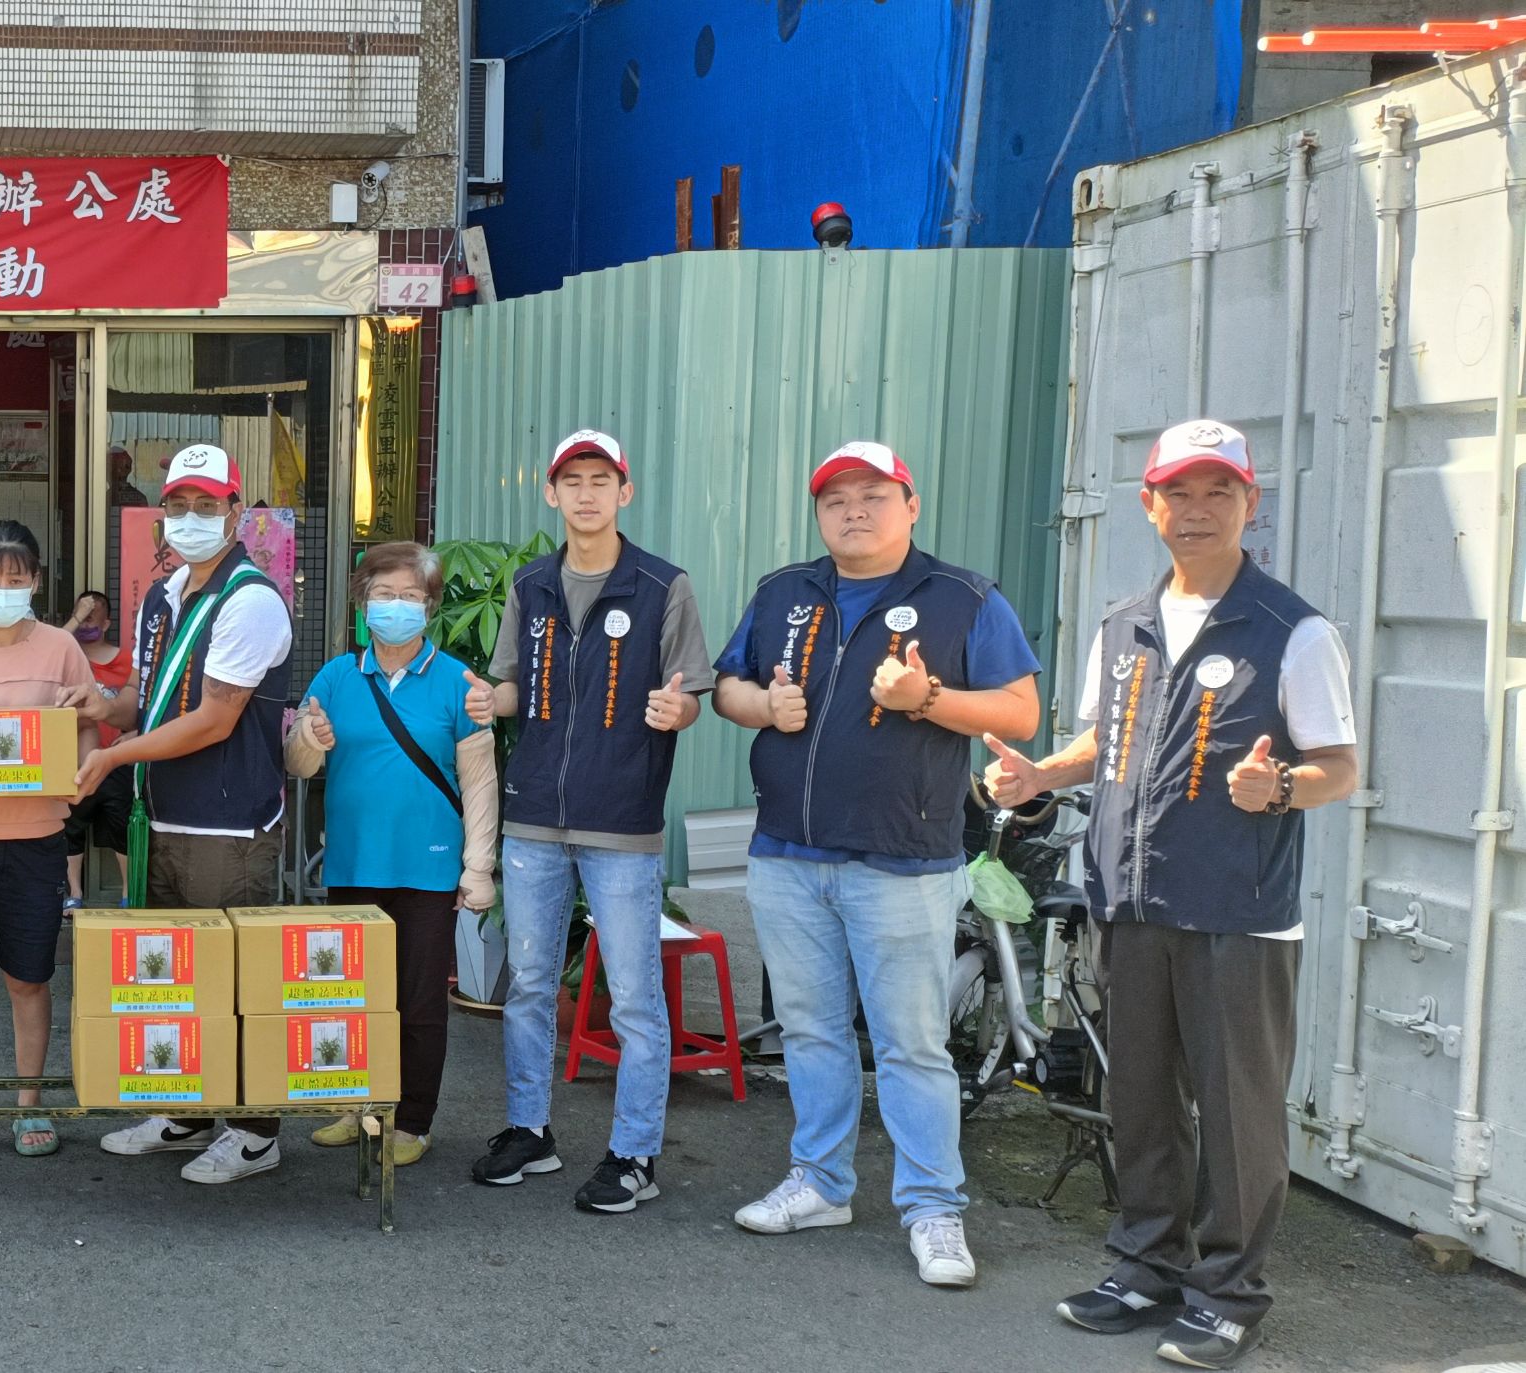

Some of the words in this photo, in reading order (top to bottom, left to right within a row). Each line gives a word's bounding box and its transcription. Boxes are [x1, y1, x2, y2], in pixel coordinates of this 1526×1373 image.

[398, 282, 429, 303] 42
[375, 381, 400, 535] 凌雲里辦公處
